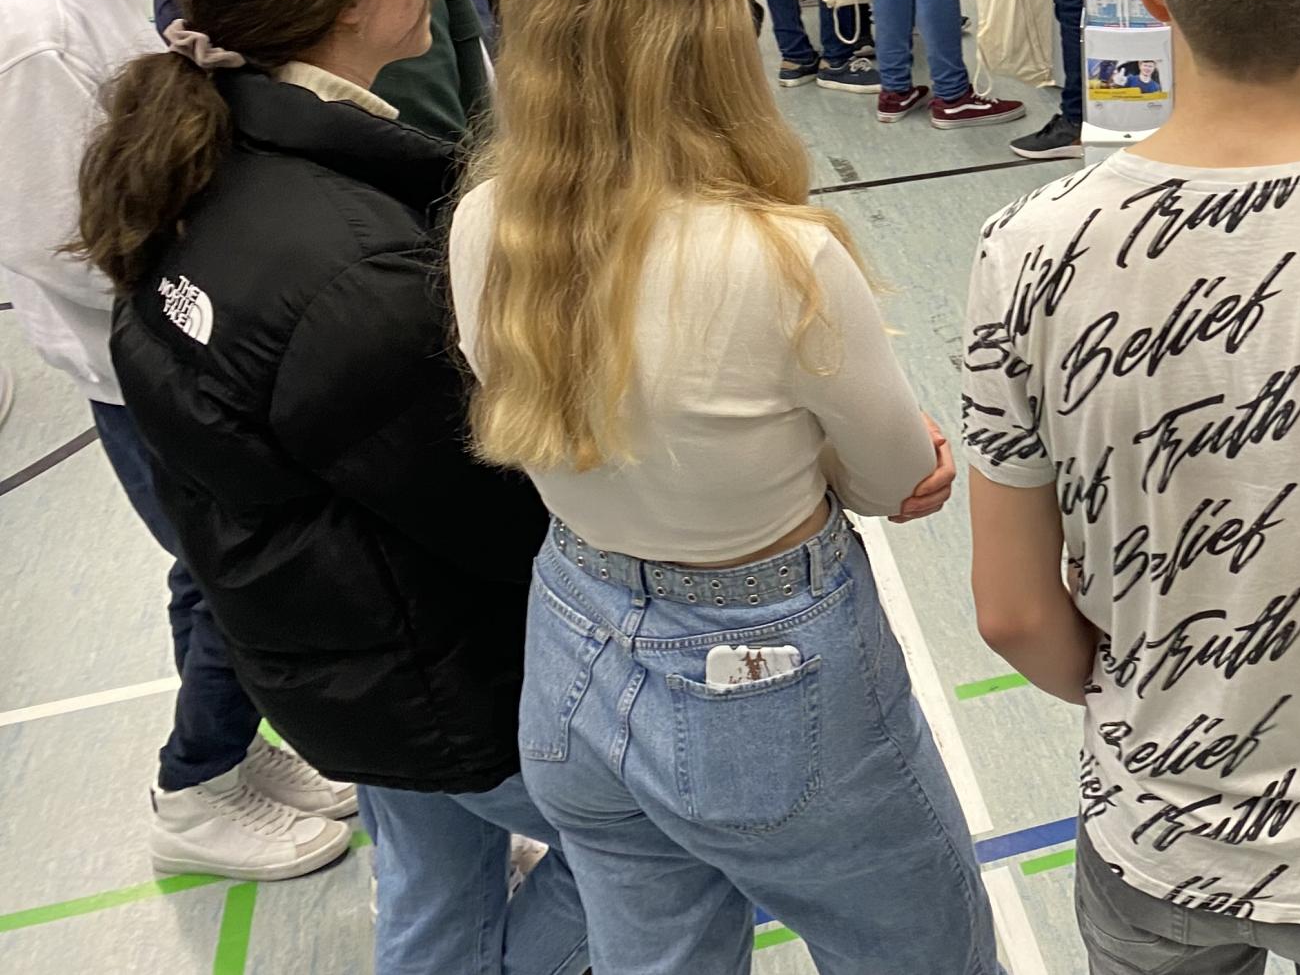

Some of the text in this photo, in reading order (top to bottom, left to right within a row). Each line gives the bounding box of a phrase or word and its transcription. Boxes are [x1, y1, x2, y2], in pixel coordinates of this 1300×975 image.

[158, 277, 195, 315] NORTH
[174, 275, 200, 302] THE
[163, 302, 189, 327] FACE
[1057, 251, 1296, 416] Belief
